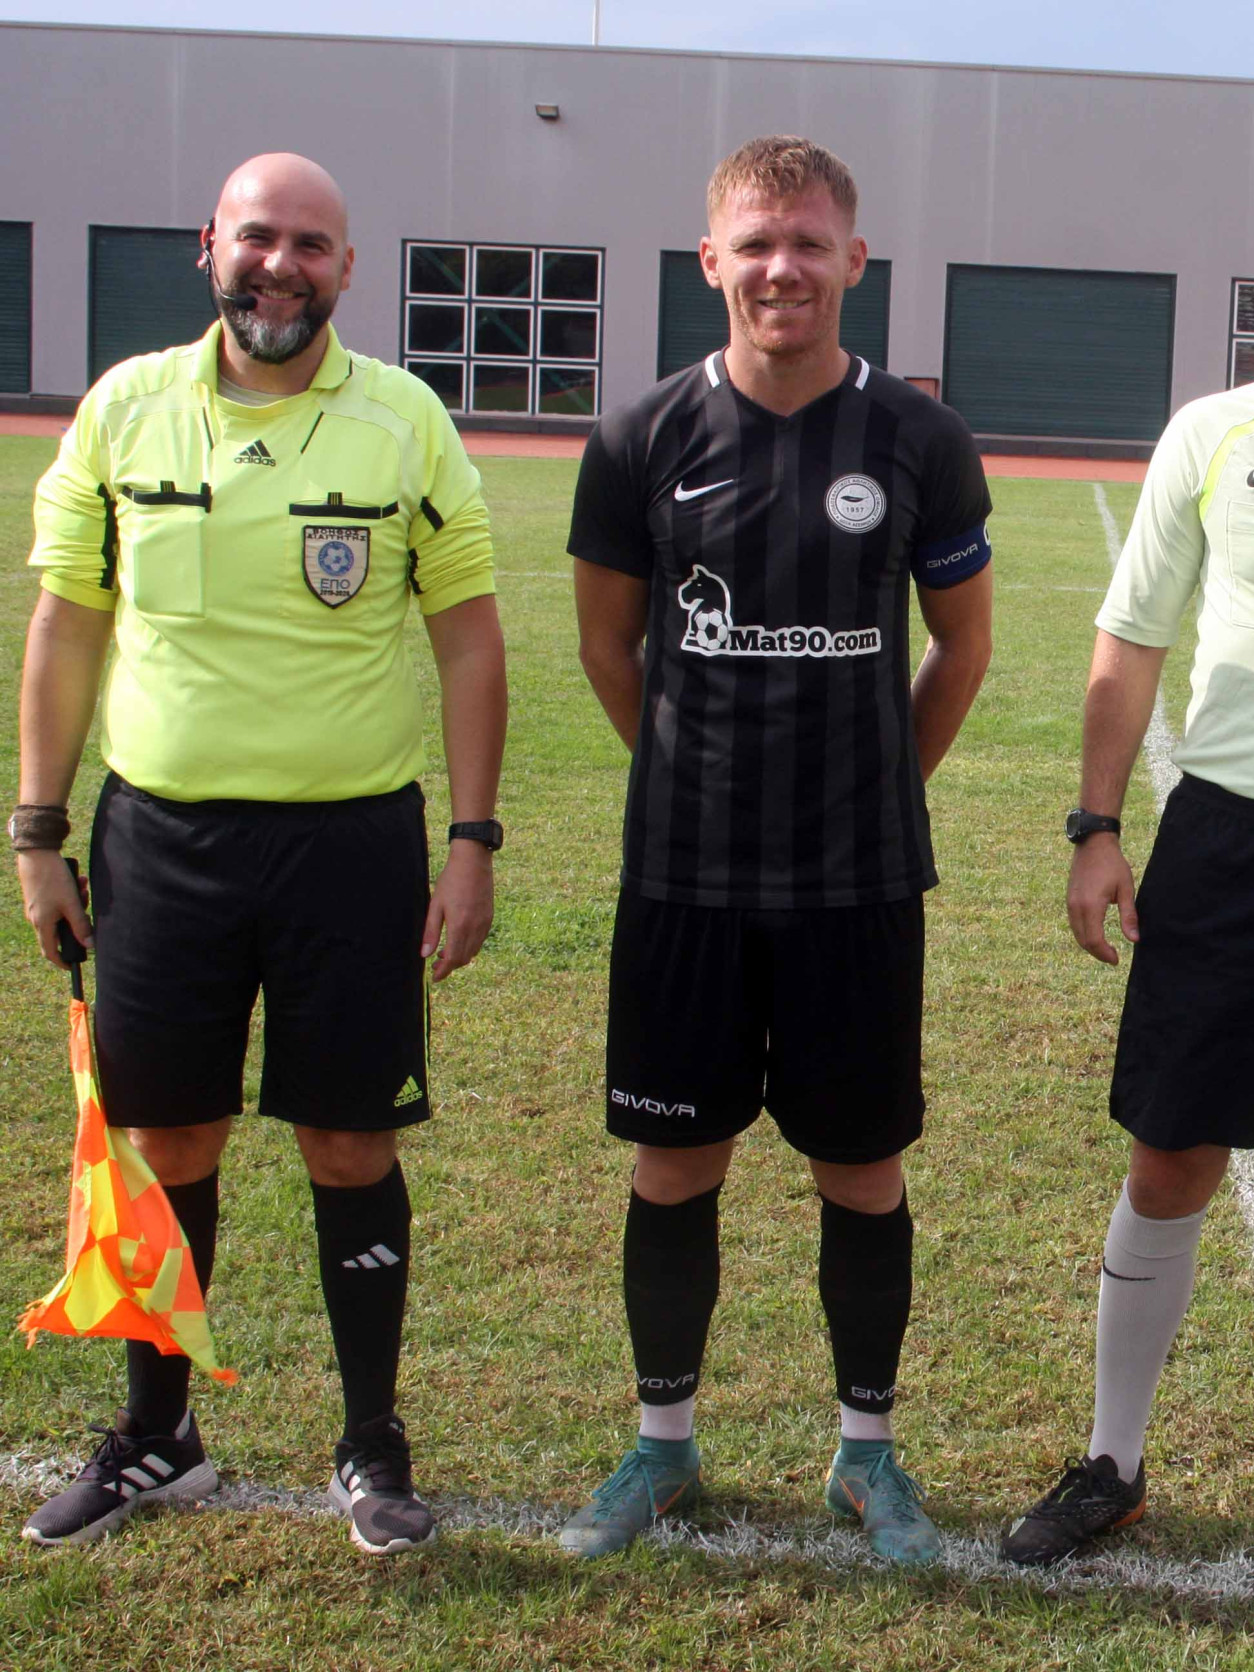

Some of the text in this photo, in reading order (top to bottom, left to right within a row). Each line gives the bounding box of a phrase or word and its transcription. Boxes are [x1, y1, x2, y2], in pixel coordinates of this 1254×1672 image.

[233, 455, 276, 467] adidas
[926, 543, 979, 569] GIVOVA
[729, 627, 879, 655] Mat90.com
[393, 1090, 423, 1107] adidas
[611, 1088, 696, 1118] GIVOVA
